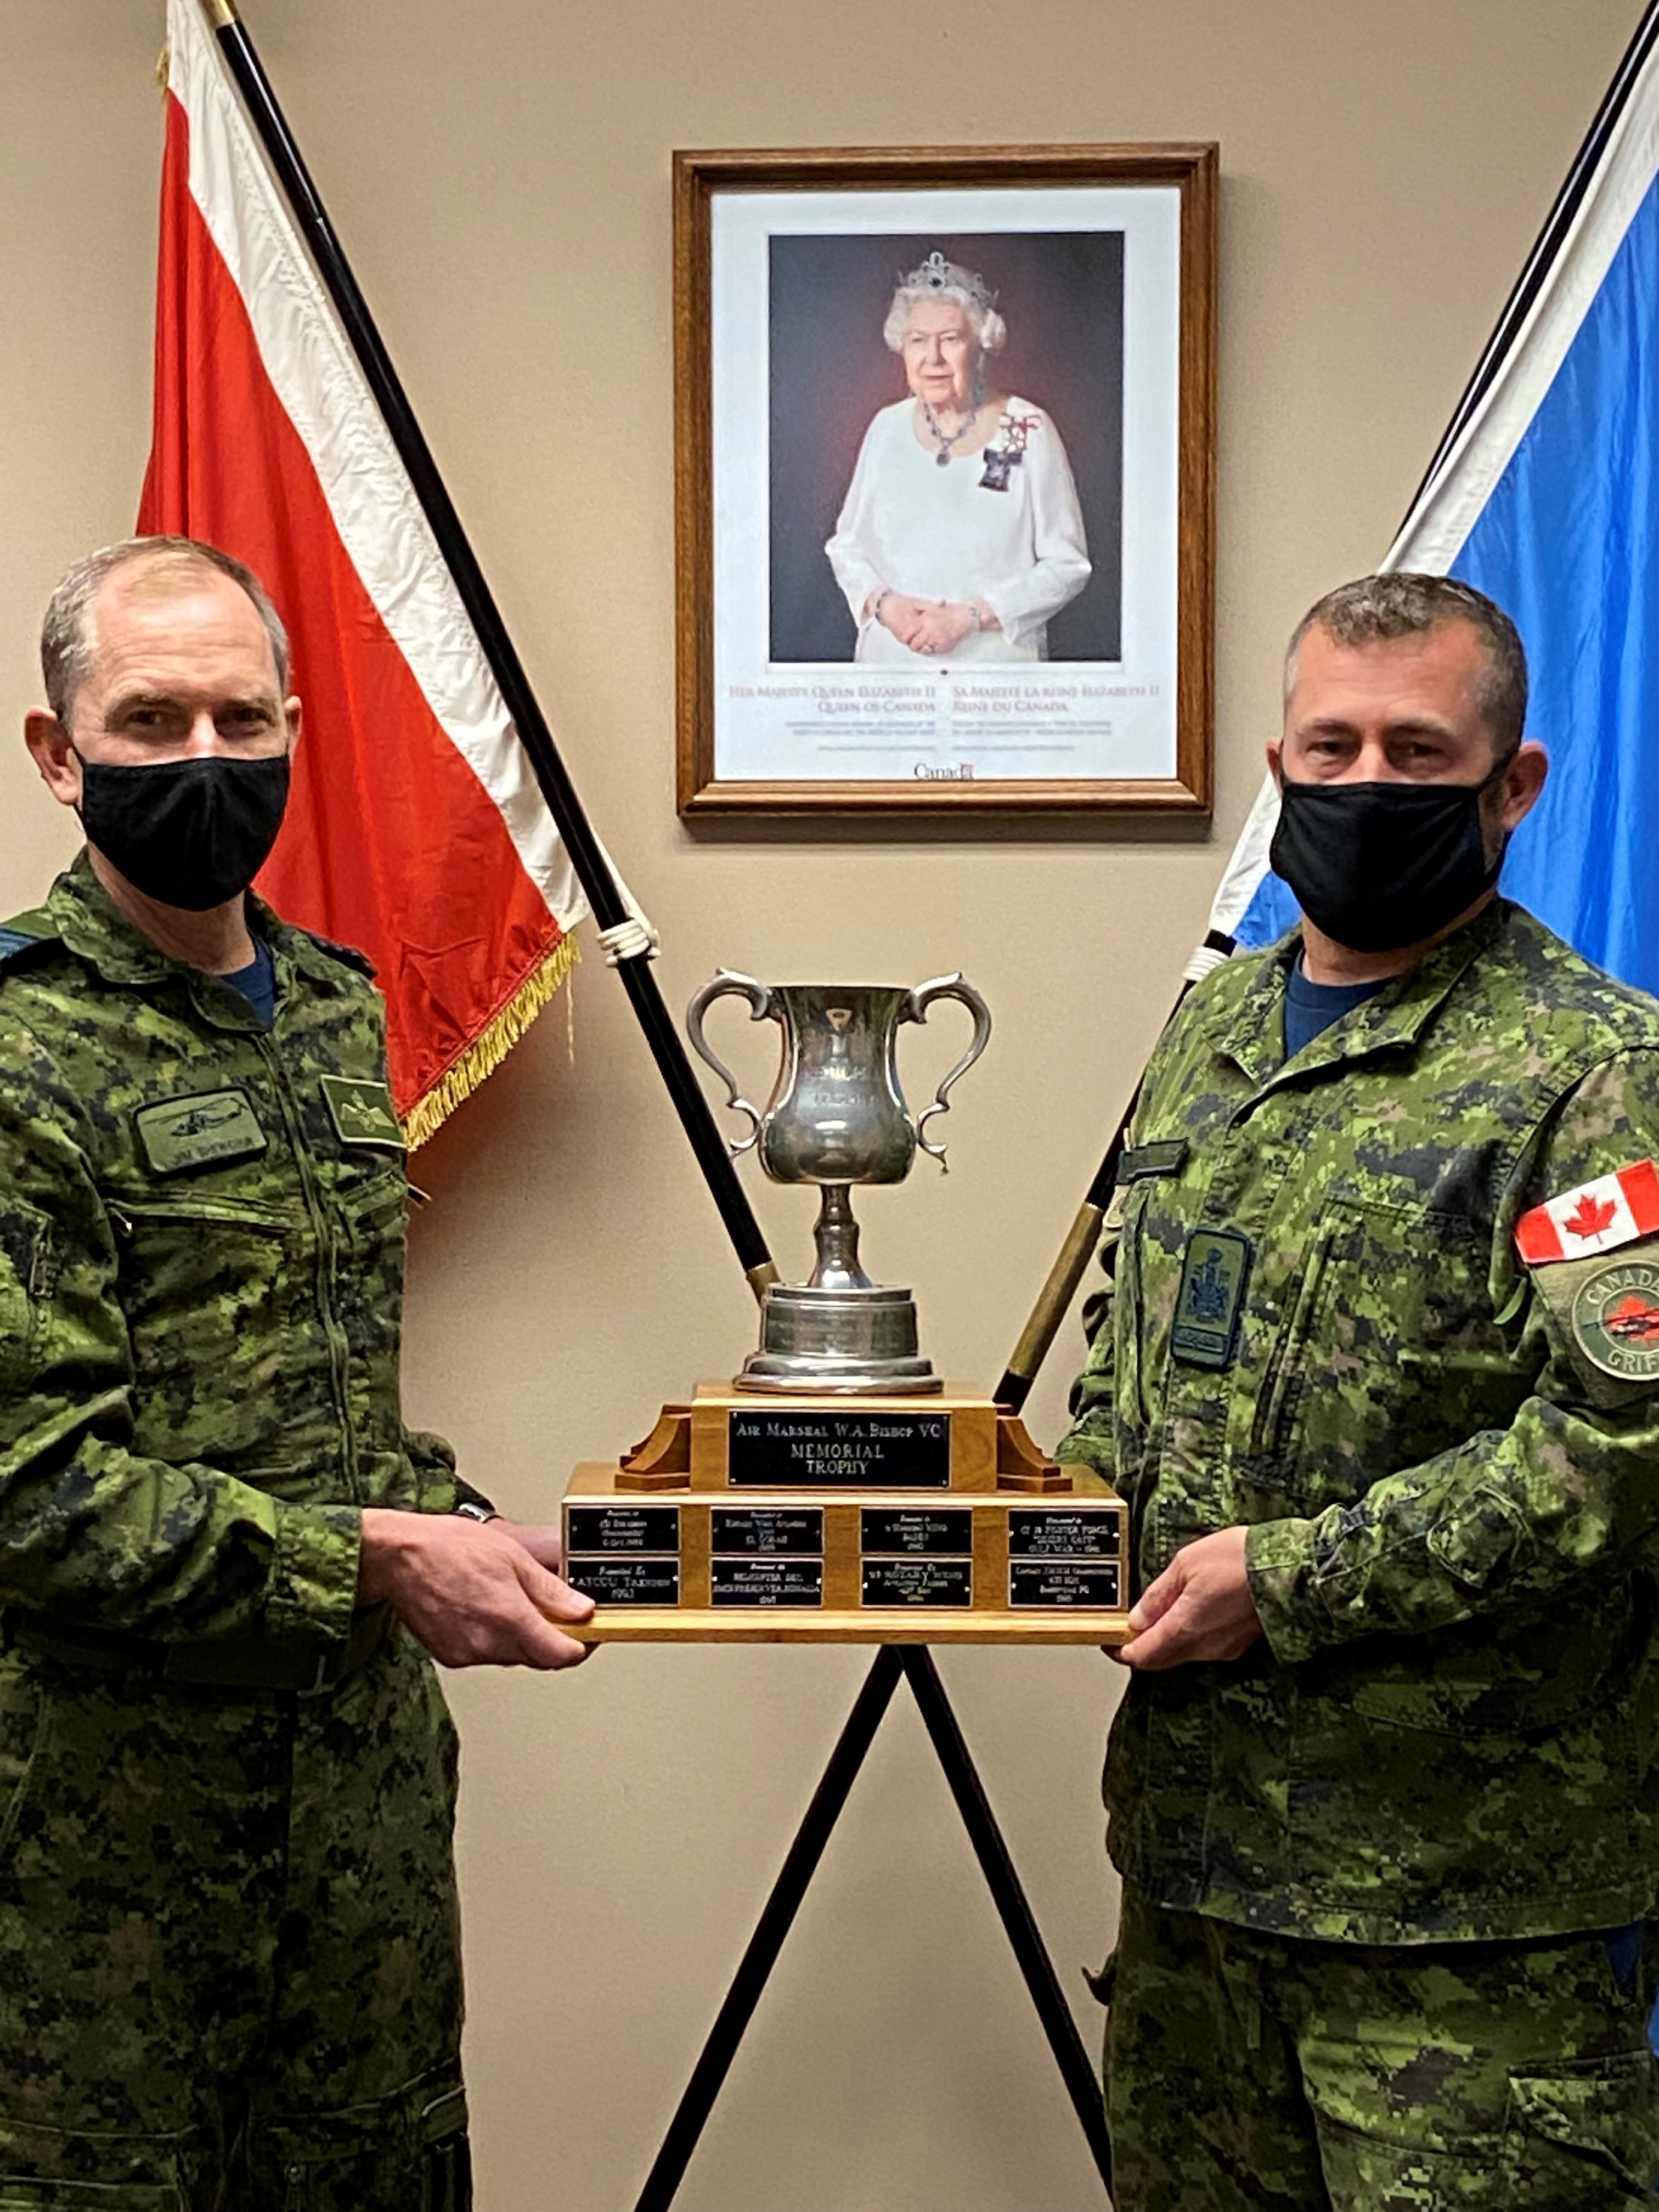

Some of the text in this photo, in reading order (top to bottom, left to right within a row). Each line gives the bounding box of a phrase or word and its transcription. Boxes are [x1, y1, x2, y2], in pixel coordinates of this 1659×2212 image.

[1607, 1348, 1659, 1373] GRIF
[791, 1443, 885, 1459] MEMORIAL
[805, 1460, 870, 1475] TROPHY
